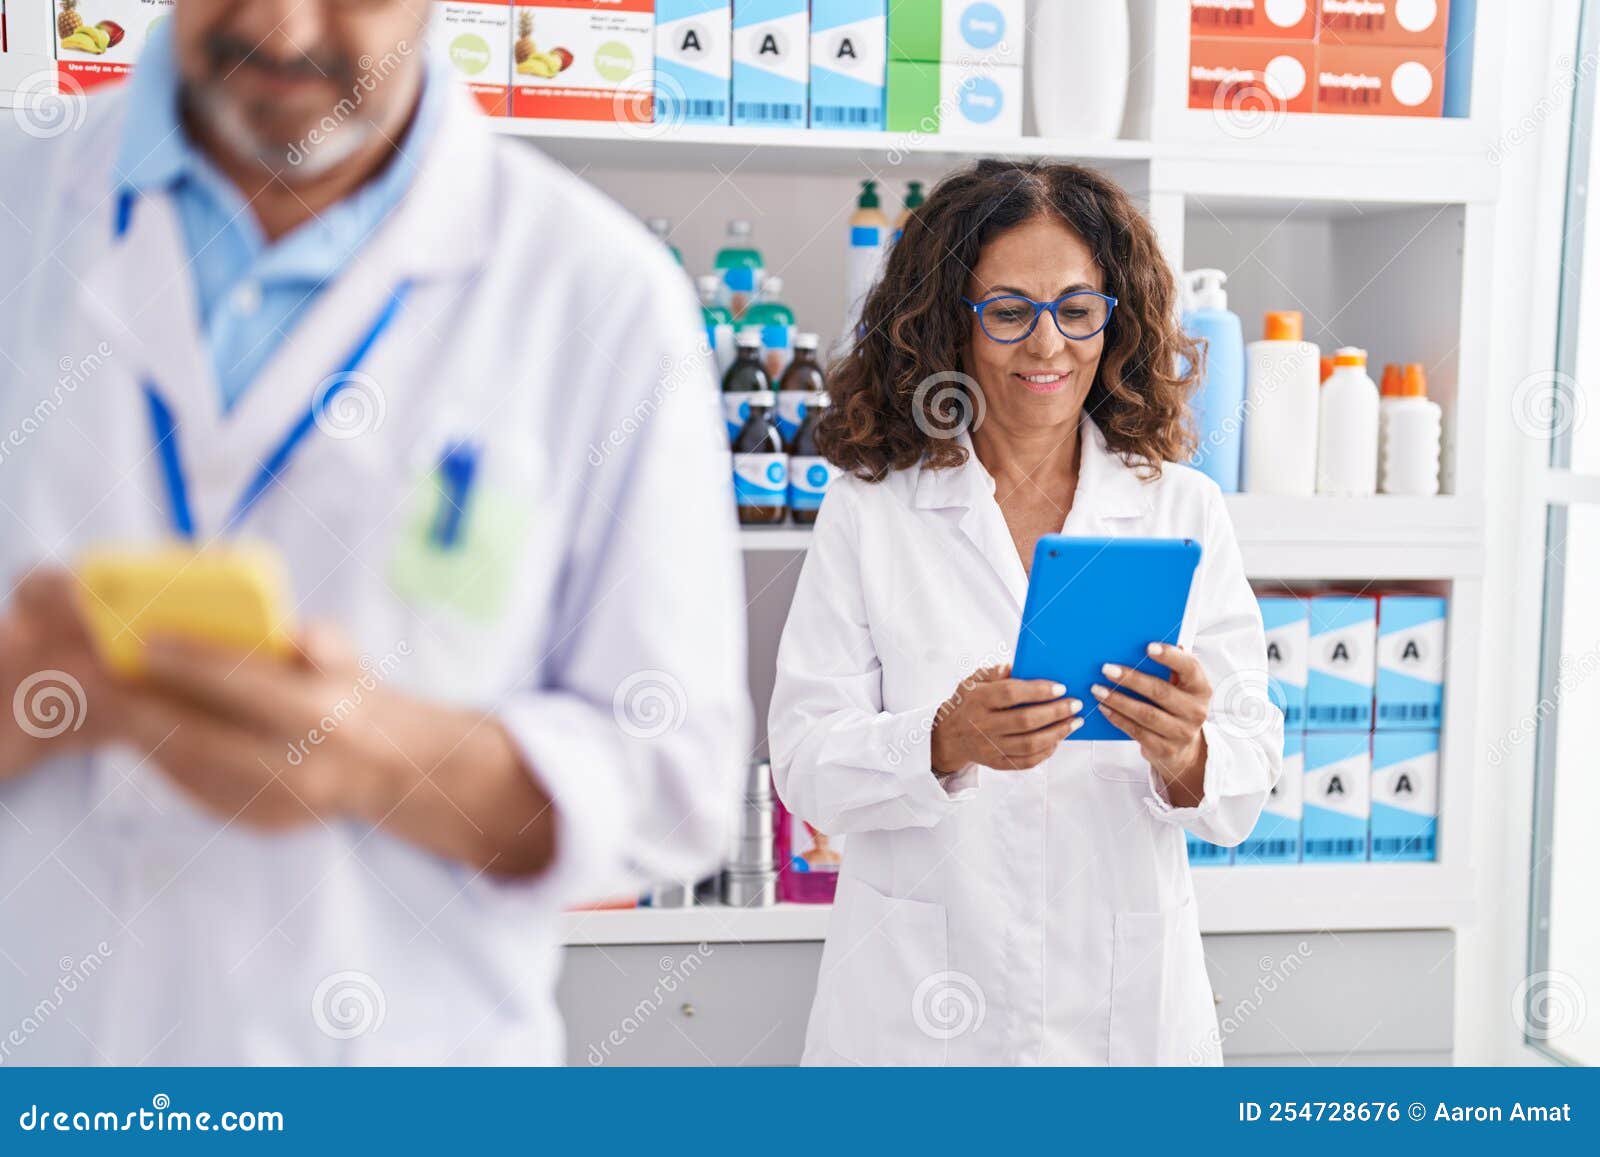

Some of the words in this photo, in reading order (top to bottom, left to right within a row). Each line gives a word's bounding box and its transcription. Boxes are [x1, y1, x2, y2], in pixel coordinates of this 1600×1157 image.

[680, 28, 703, 51] A
[759, 33, 780, 55] A
[836, 37, 857, 59] A
[1331, 641, 1350, 662] A
[1402, 640, 1421, 660] A
[1326, 775, 1344, 796] A
[1395, 773, 1413, 794] A
